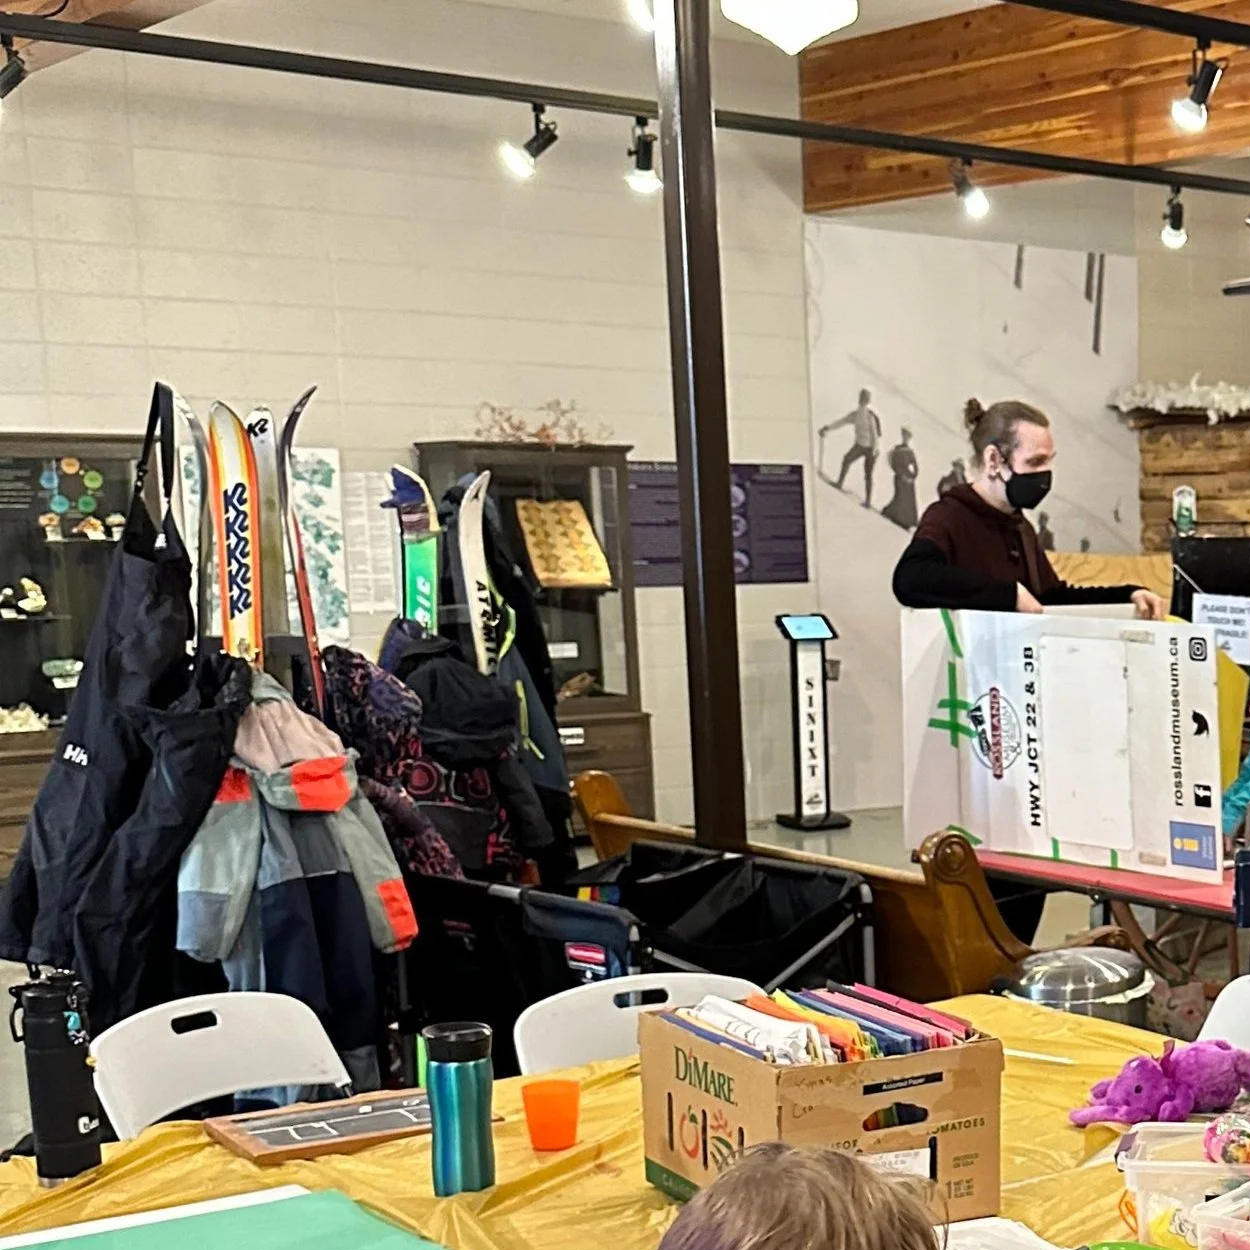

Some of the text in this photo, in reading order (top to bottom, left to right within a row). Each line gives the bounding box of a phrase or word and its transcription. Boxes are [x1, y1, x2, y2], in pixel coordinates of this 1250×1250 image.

[247, 418, 269, 438] K2
[805, 677, 818, 777] SINIXT
[1023, 646, 1042, 827] HWY JCT 22 & 3B
[1169, 636, 1184, 807] rosslandmuseum.ca
[928, 1117, 985, 1136] OMATOES
